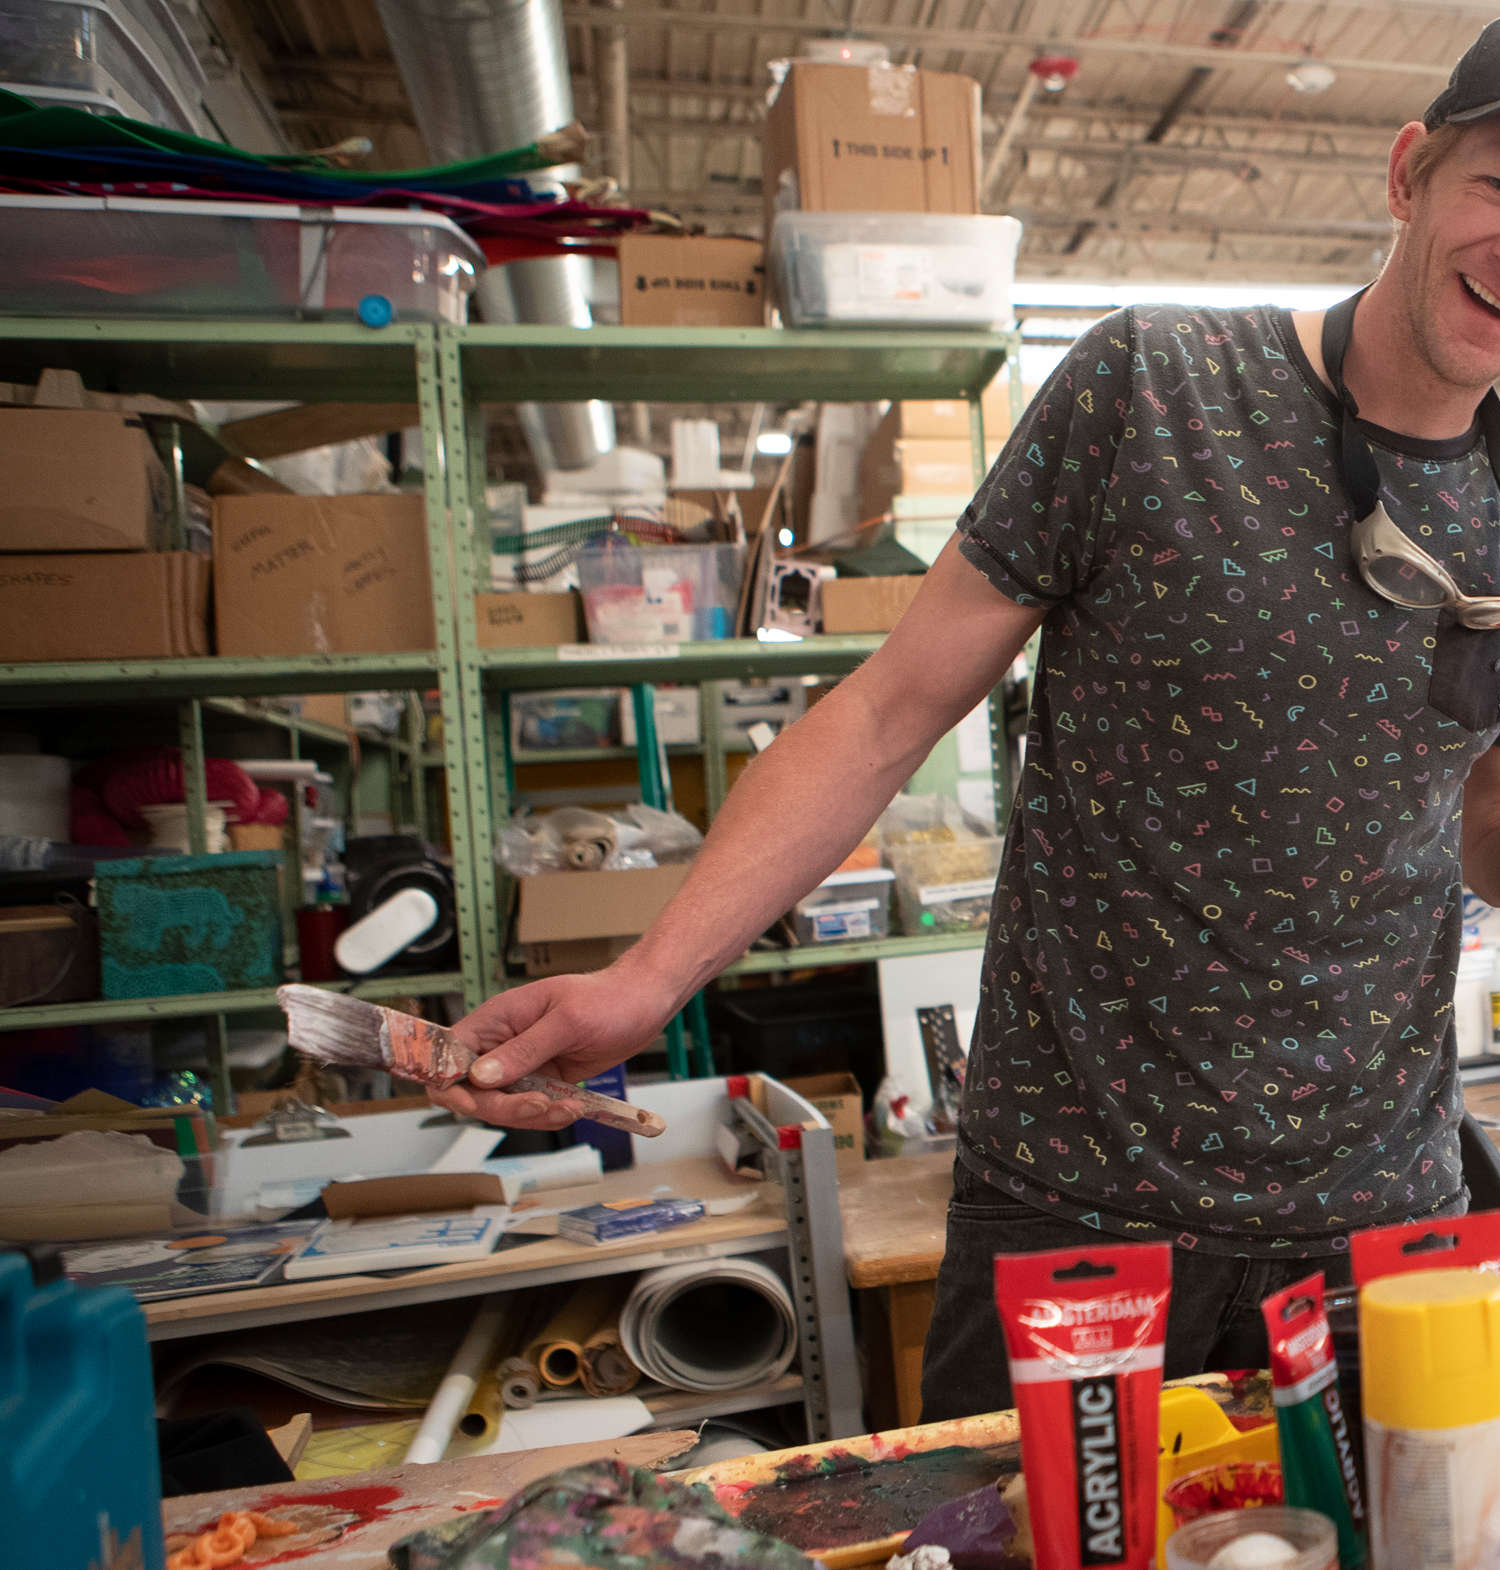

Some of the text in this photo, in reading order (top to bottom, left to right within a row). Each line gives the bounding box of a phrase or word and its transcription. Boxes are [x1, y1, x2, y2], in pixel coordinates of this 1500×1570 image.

[847, 142, 878, 157] THIS
[882, 145, 912, 160] SIDE
[1078, 1384, 1122, 1556] ACRYLIC
[1325, 1388, 1364, 1519] ACRYLIC
